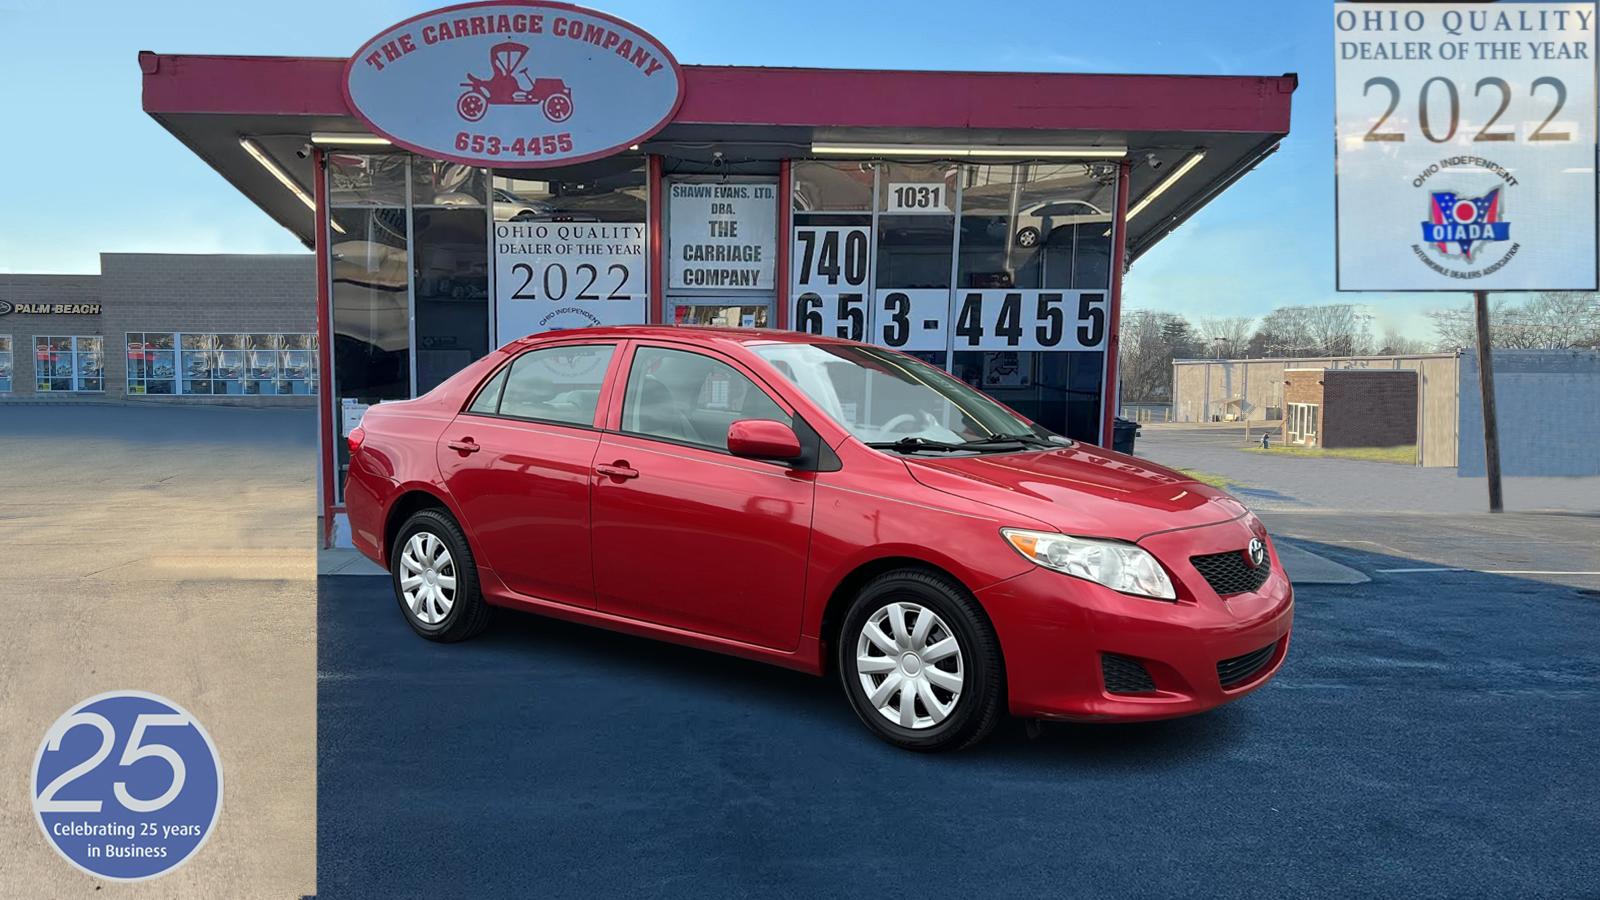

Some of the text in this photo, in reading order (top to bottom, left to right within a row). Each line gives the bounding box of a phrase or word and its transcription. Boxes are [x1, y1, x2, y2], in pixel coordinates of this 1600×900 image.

[1336, 10, 1593, 36] OHIO QUALITY
[365, 14, 664, 78] THE CARRIAGE COMPANY
[1340, 41, 1589, 60] DEALER OF THE YEAR
[1362, 76, 1571, 143] 2022
[454, 132, 573, 156] 653-4455
[1412, 155, 1519, 188] OHIO INDEPENDENT
[672, 185, 712, 199] SHAWN
[754, 187, 774, 200] LTD.
[894, 186, 940, 208] 1031
[711, 203, 736, 215] DBA.
[497, 225, 645, 241] OHIO QUALITY
[708, 220, 738, 238] THE
[1432, 223, 1495, 241] OIADA
[499, 243, 641, 255] DEALER OF THE YEAR
[682, 244, 762, 262] CARRIAGE
[797, 230, 868, 285] 740
[511, 262, 631, 301] 2022
[683, 267, 760, 286] COMPANY
[14, 303, 101, 315] PALM BEACH
[539, 307, 601, 326] OHIO INDEPENDENT
